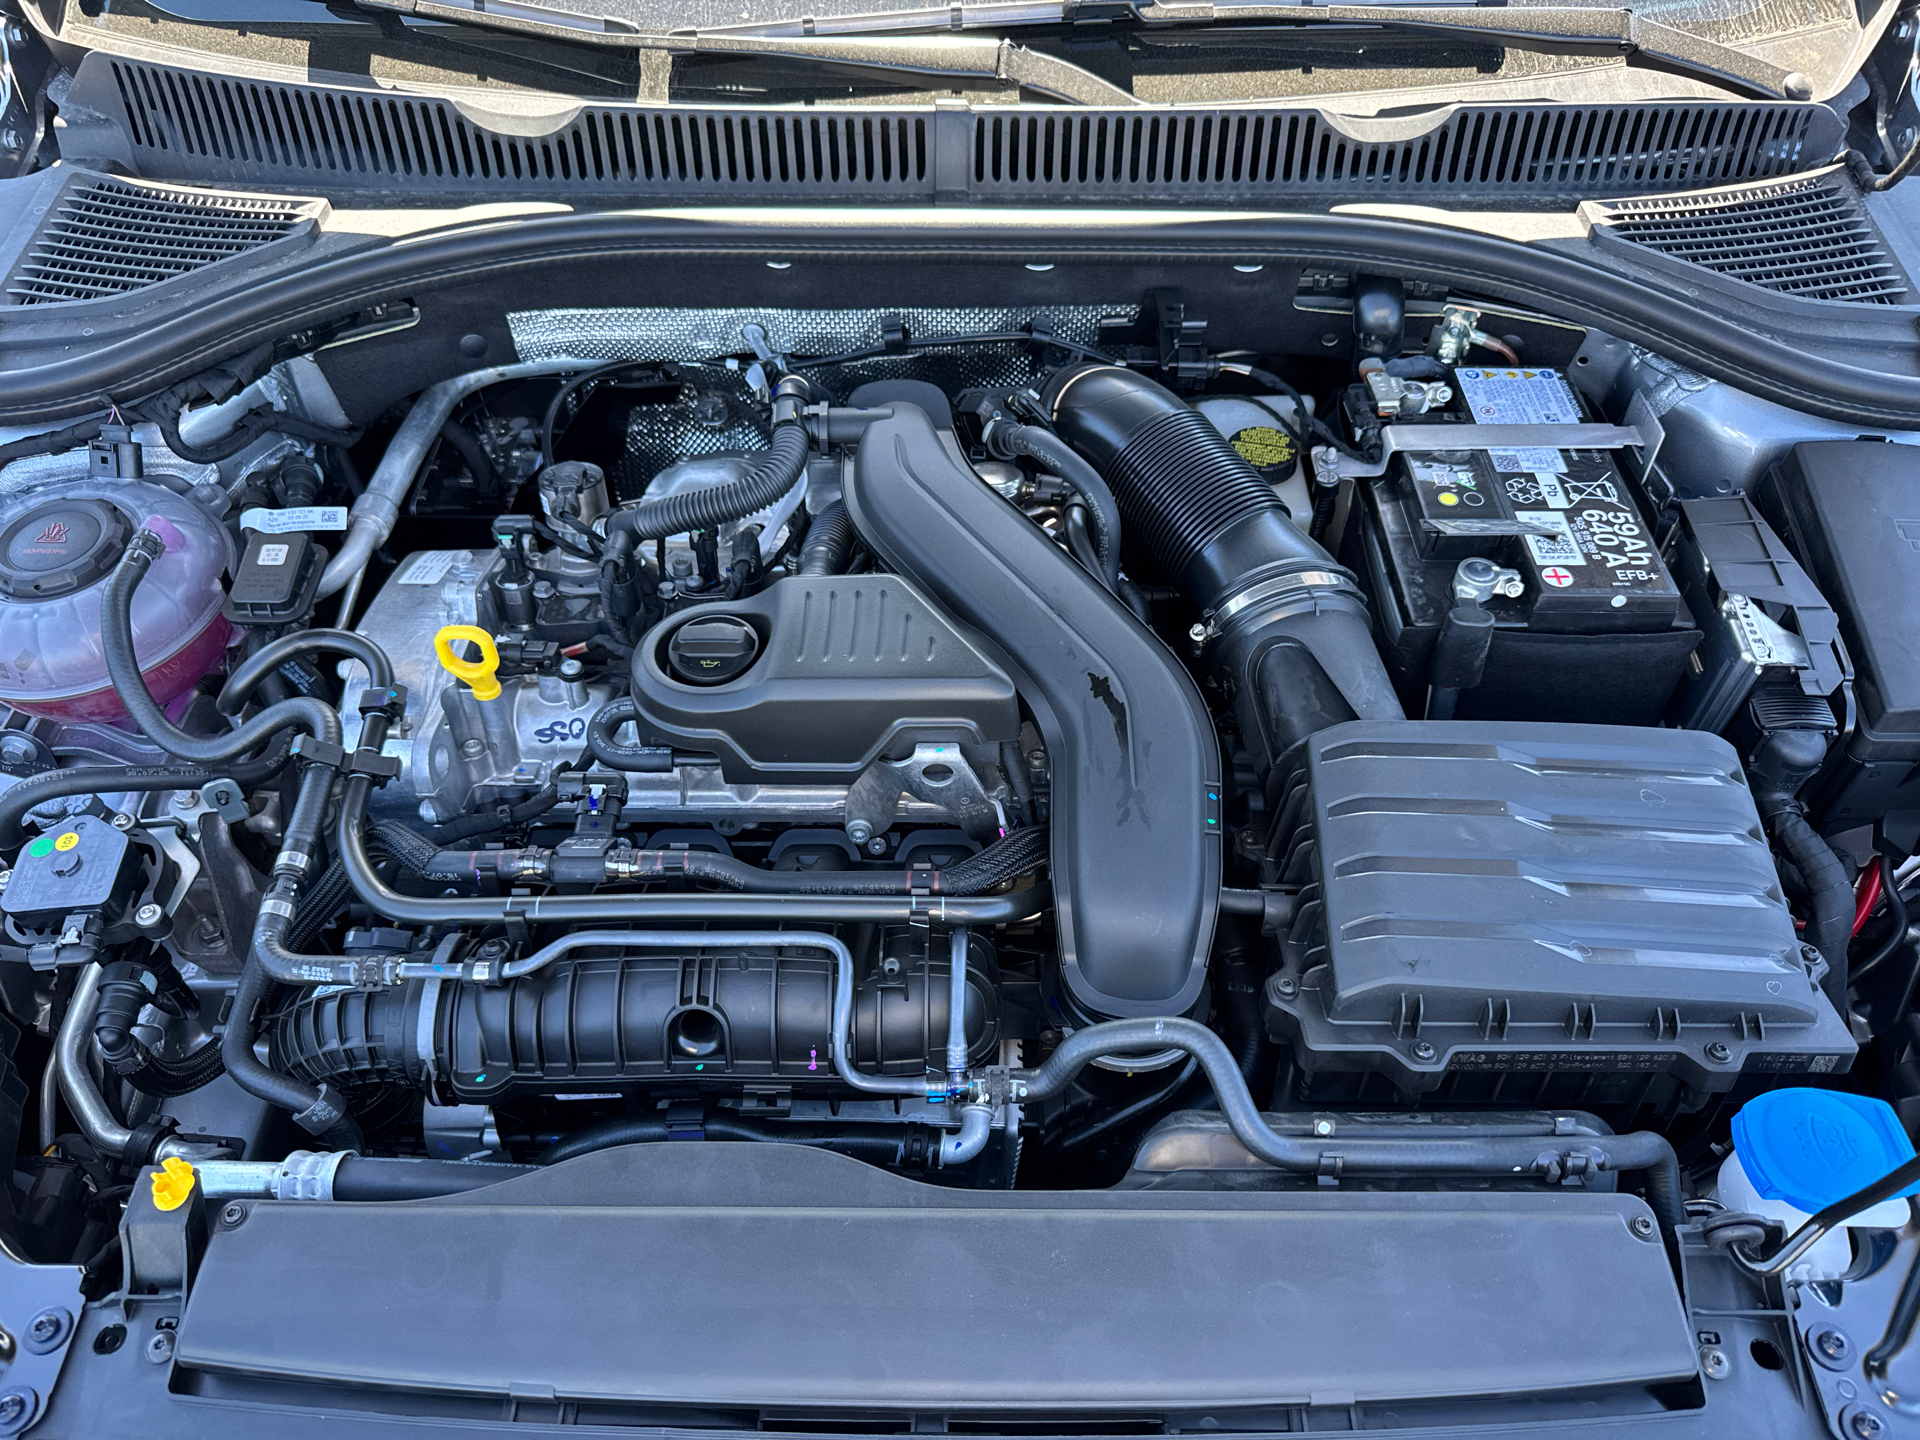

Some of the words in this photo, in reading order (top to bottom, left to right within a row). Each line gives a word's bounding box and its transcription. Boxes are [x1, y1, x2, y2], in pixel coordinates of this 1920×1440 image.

[1544, 484, 1559, 497] Pb
[1582, 510, 1620, 546] 640
[1607, 512, 1653, 565] 59Ah
[1600, 551, 1629, 568] A
[1615, 570, 1659, 580] EFB+
